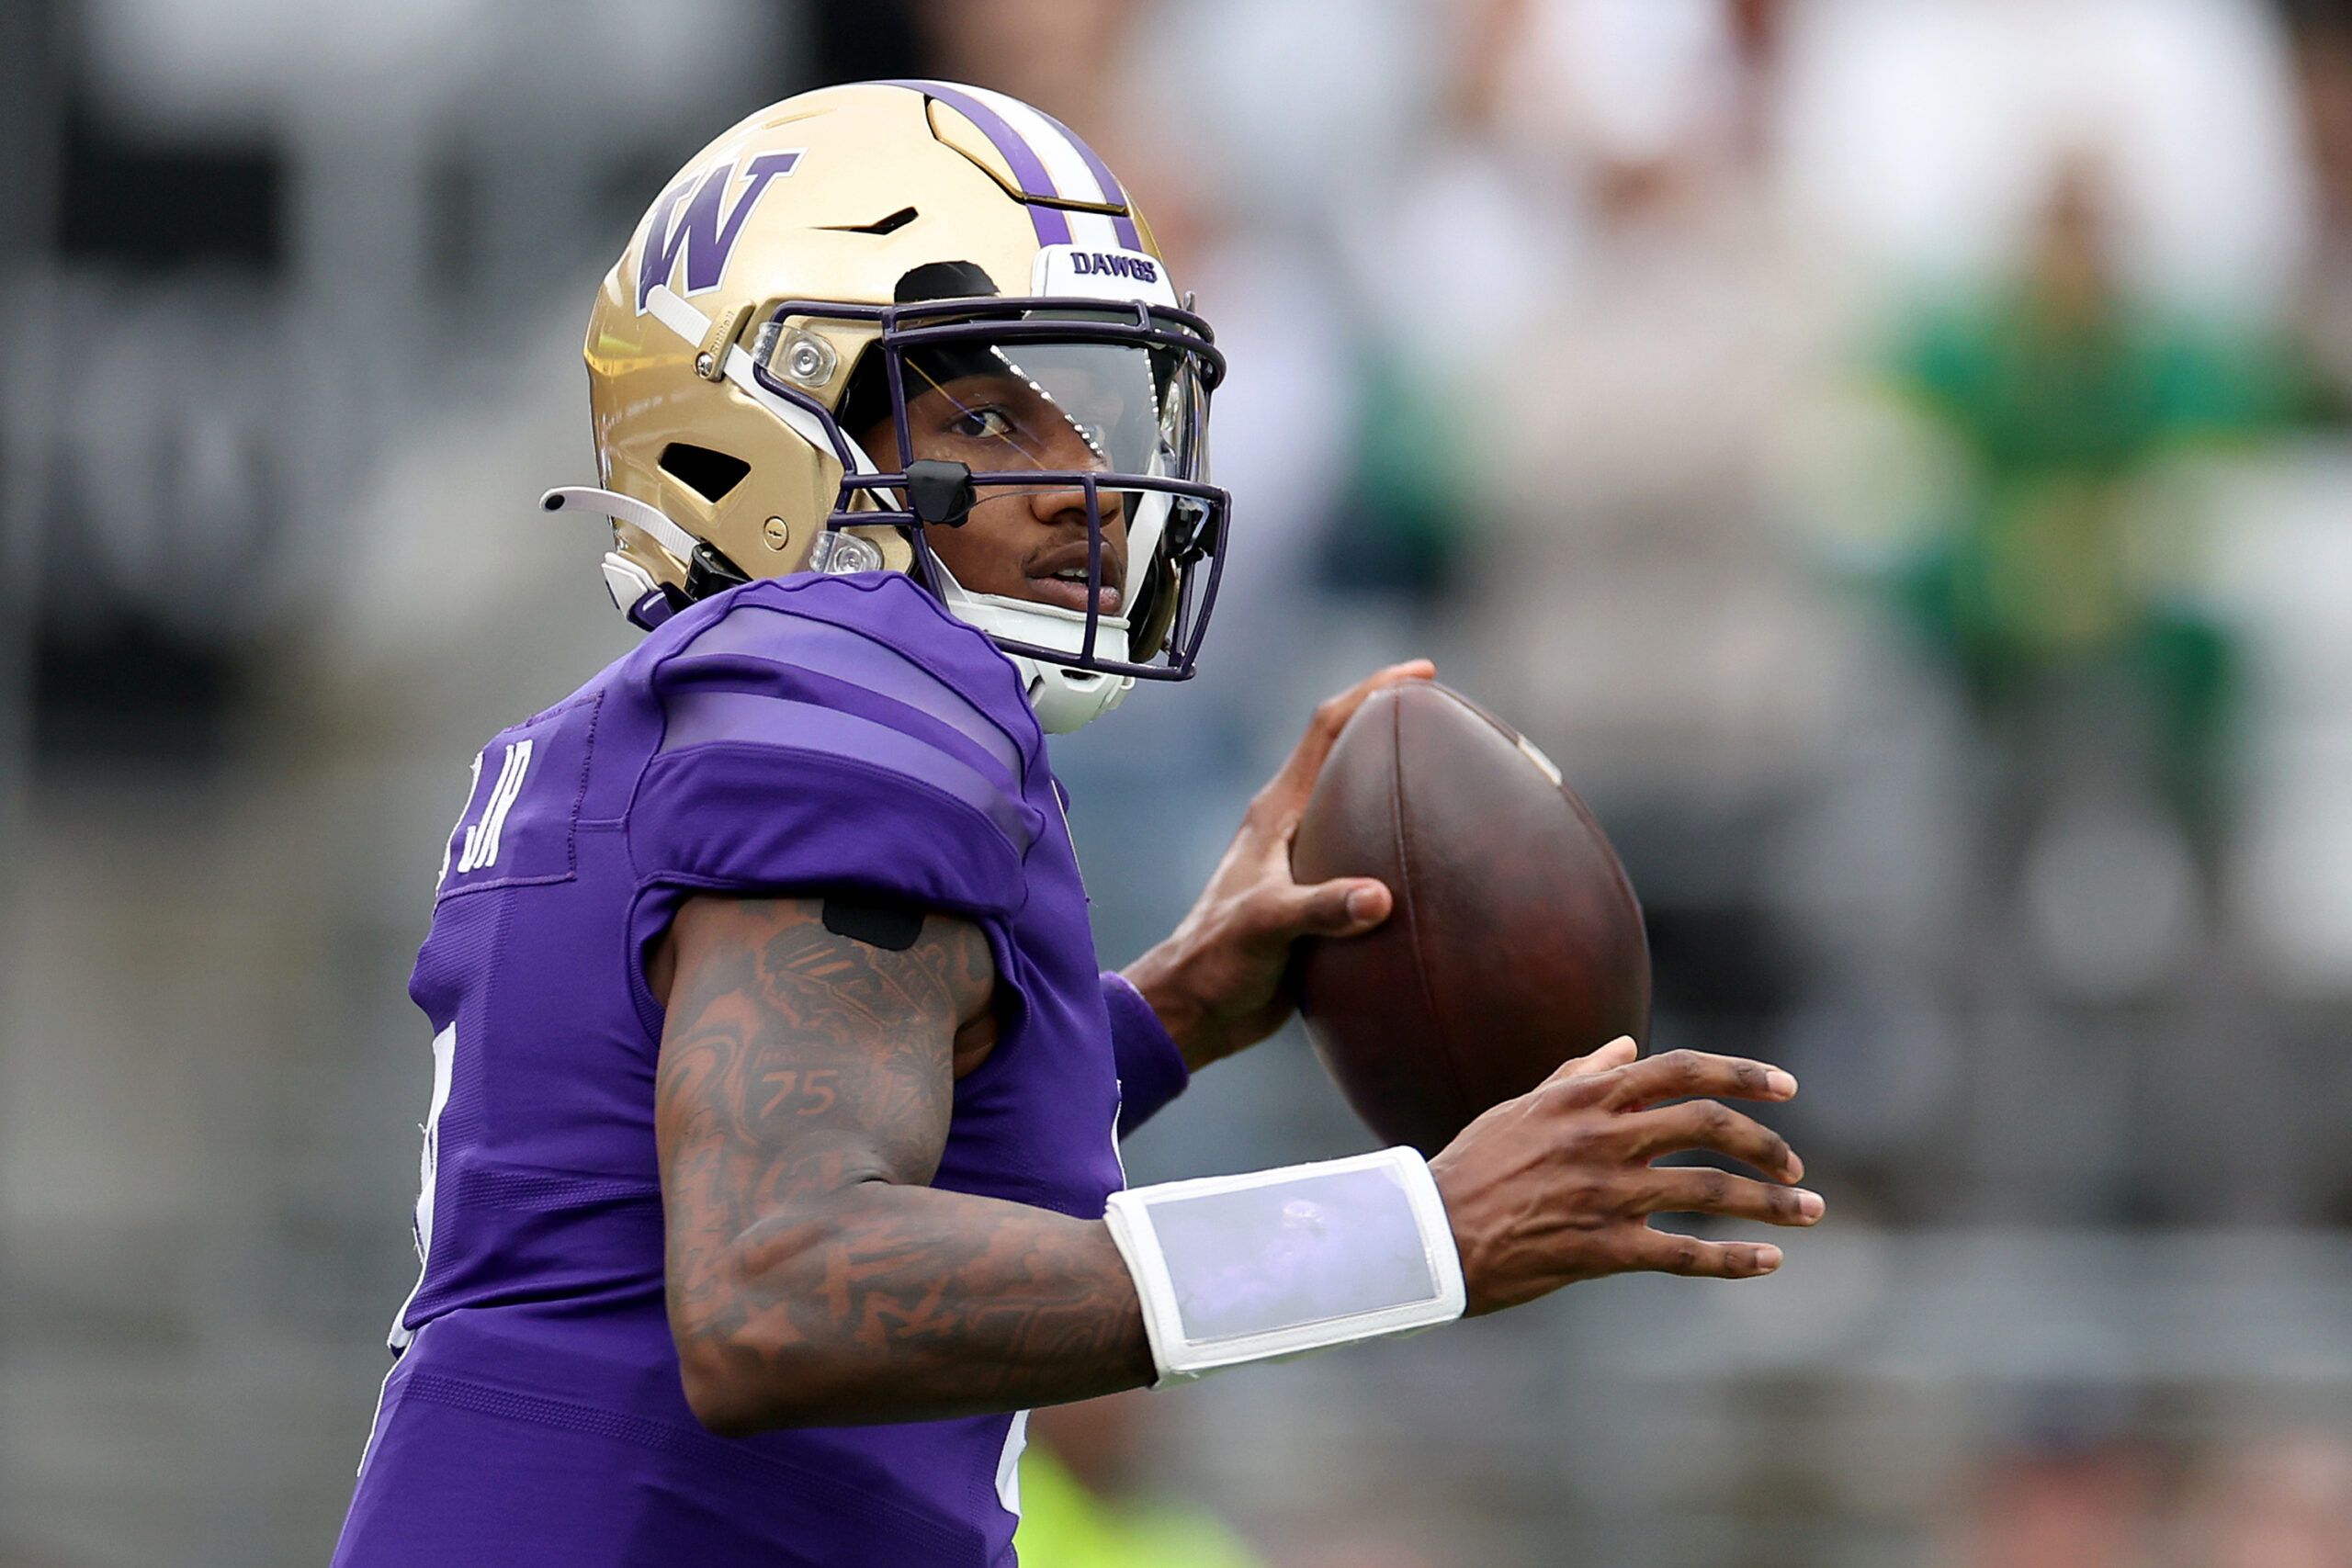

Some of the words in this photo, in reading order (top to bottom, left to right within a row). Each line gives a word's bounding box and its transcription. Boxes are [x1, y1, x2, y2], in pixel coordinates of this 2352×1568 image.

[637, 148, 807, 316] W
[1069, 252, 1159, 284] DAWGS
[758, 1069, 840, 1120] 75
